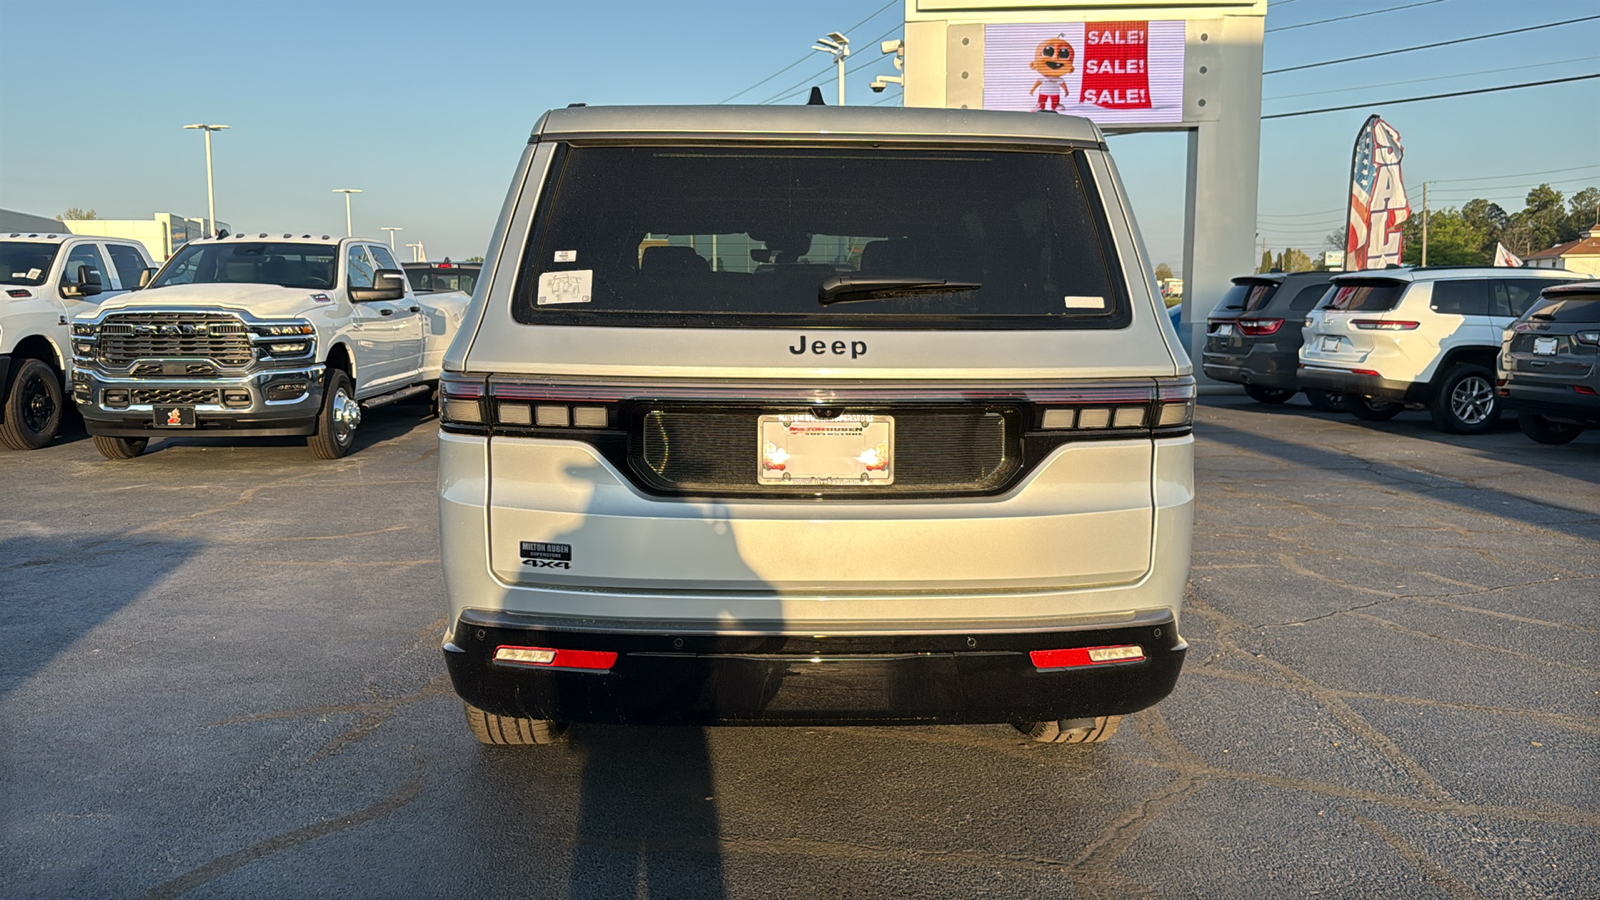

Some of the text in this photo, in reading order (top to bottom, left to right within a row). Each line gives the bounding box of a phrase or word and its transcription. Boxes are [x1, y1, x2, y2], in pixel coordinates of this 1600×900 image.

[1088, 30, 1144, 45] SALE!
[1086, 59, 1144, 74] SALE!
[1083, 88, 1146, 104] SALE!
[789, 335, 867, 359] Jeep
[522, 542, 569, 553] MILTON RUBEN
